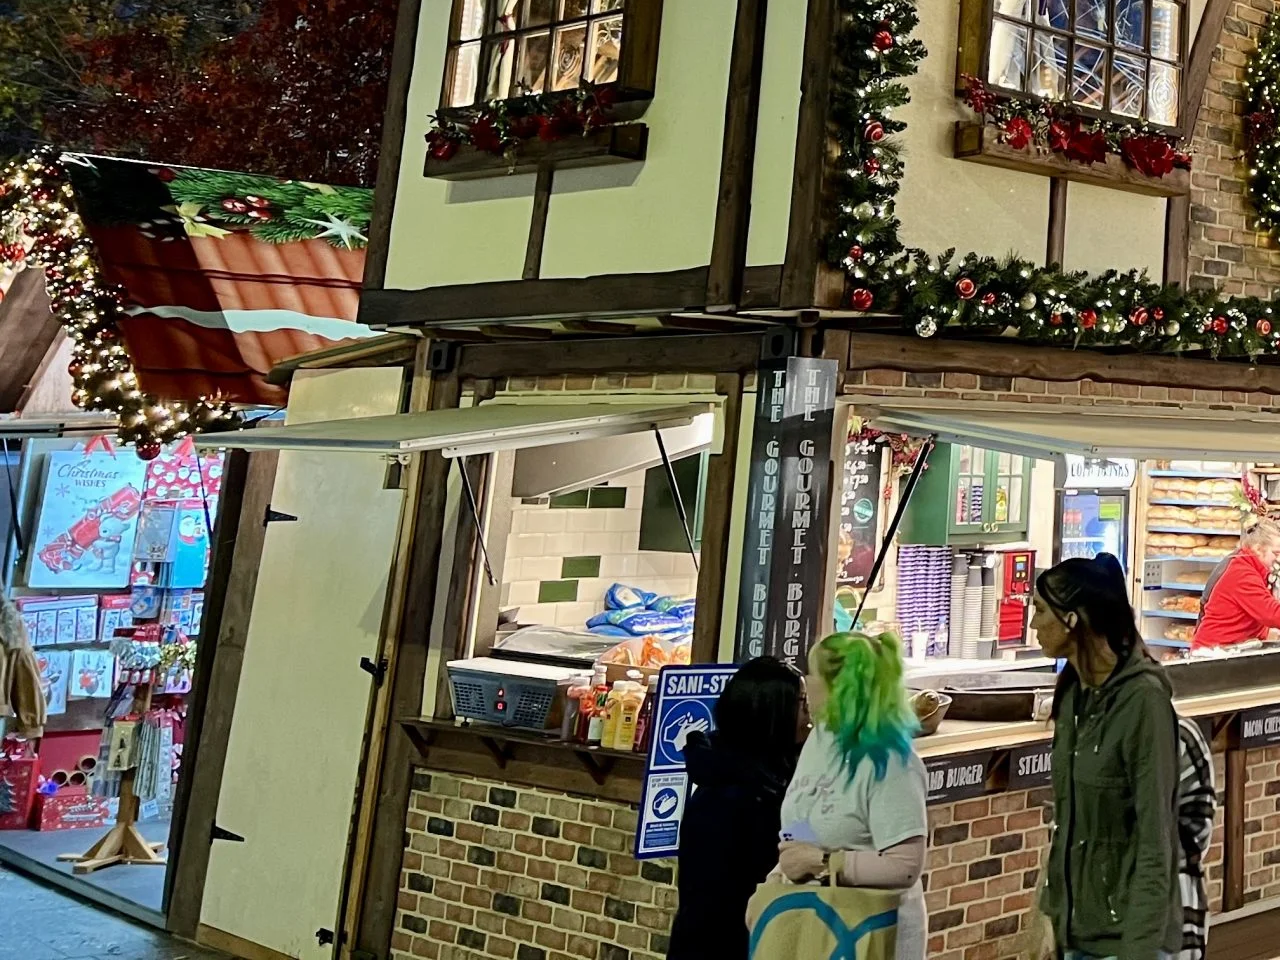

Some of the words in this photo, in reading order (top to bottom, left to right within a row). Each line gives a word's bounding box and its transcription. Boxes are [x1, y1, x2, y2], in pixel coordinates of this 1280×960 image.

[771, 370, 786, 423] THE
[804, 369, 822, 422] THE
[57, 460, 120, 480] Christmas
[75, 480, 106, 488] WISHES
[757, 440, 780, 565] GOURMET
[791, 440, 815, 565] GOURMET
[749, 583, 767, 658] BURG
[667, 674, 734, 695] SANI-ST
[1244, 720, 1263, 738] BACON
[929, 770, 944, 791] MB
[946, 764, 983, 789] BURGER
